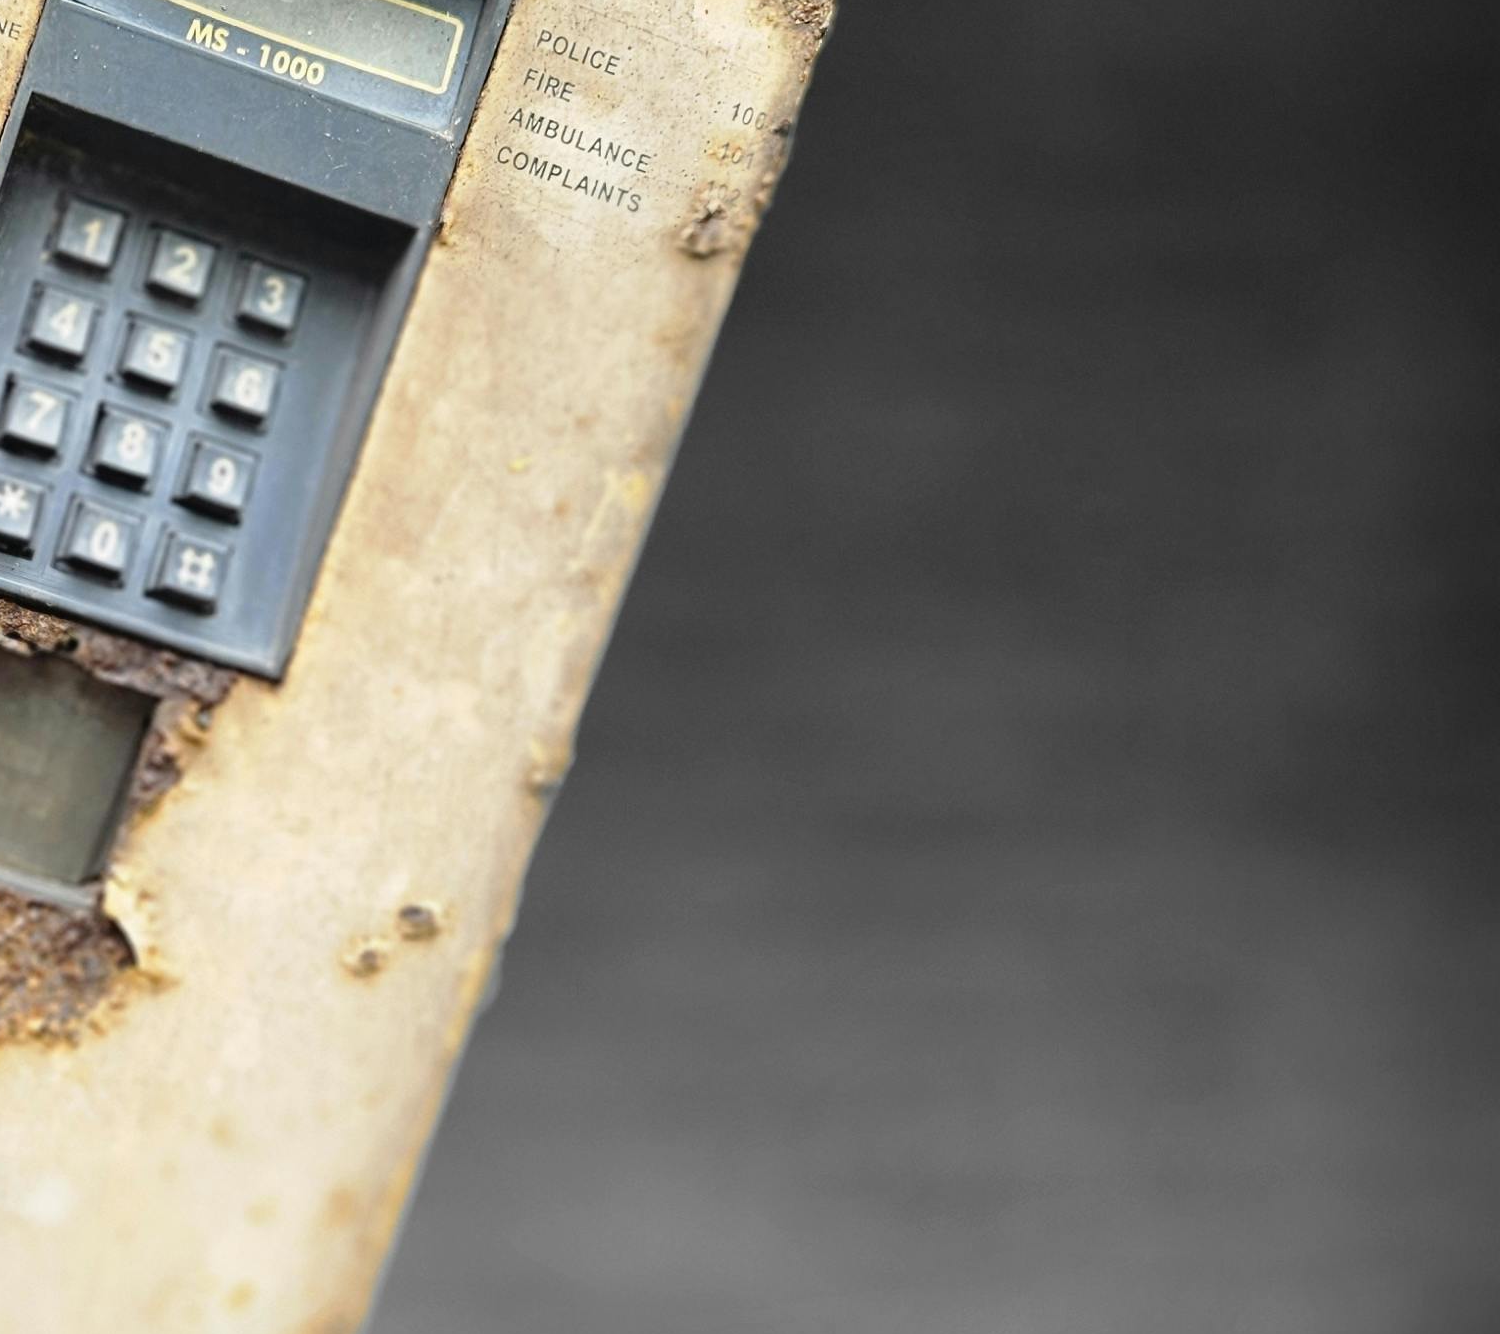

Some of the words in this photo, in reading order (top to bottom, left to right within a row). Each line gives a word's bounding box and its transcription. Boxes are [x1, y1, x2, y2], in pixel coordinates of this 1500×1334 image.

[186, 18, 230, 54] MS
[258, 43, 326, 86] 1000
[523, 68, 576, 103] FIRE
[536, 29, 621, 76] POLICE
[508, 107, 653, 174] AMBULANCE
[497, 145, 643, 214] COMPLAINTS
[84, 220, 100, 252] 1
[165, 245, 196, 280] 2
[259, 277, 285, 315] 3
[49, 301, 79, 338] 4
[146, 332, 176, 366] 5
[234, 369, 262, 404] 6
[26, 395, 57, 431] 7
[117, 421, 148, 459] 8
[206, 457, 237, 493] 9
[89, 521, 119, 559] 0
